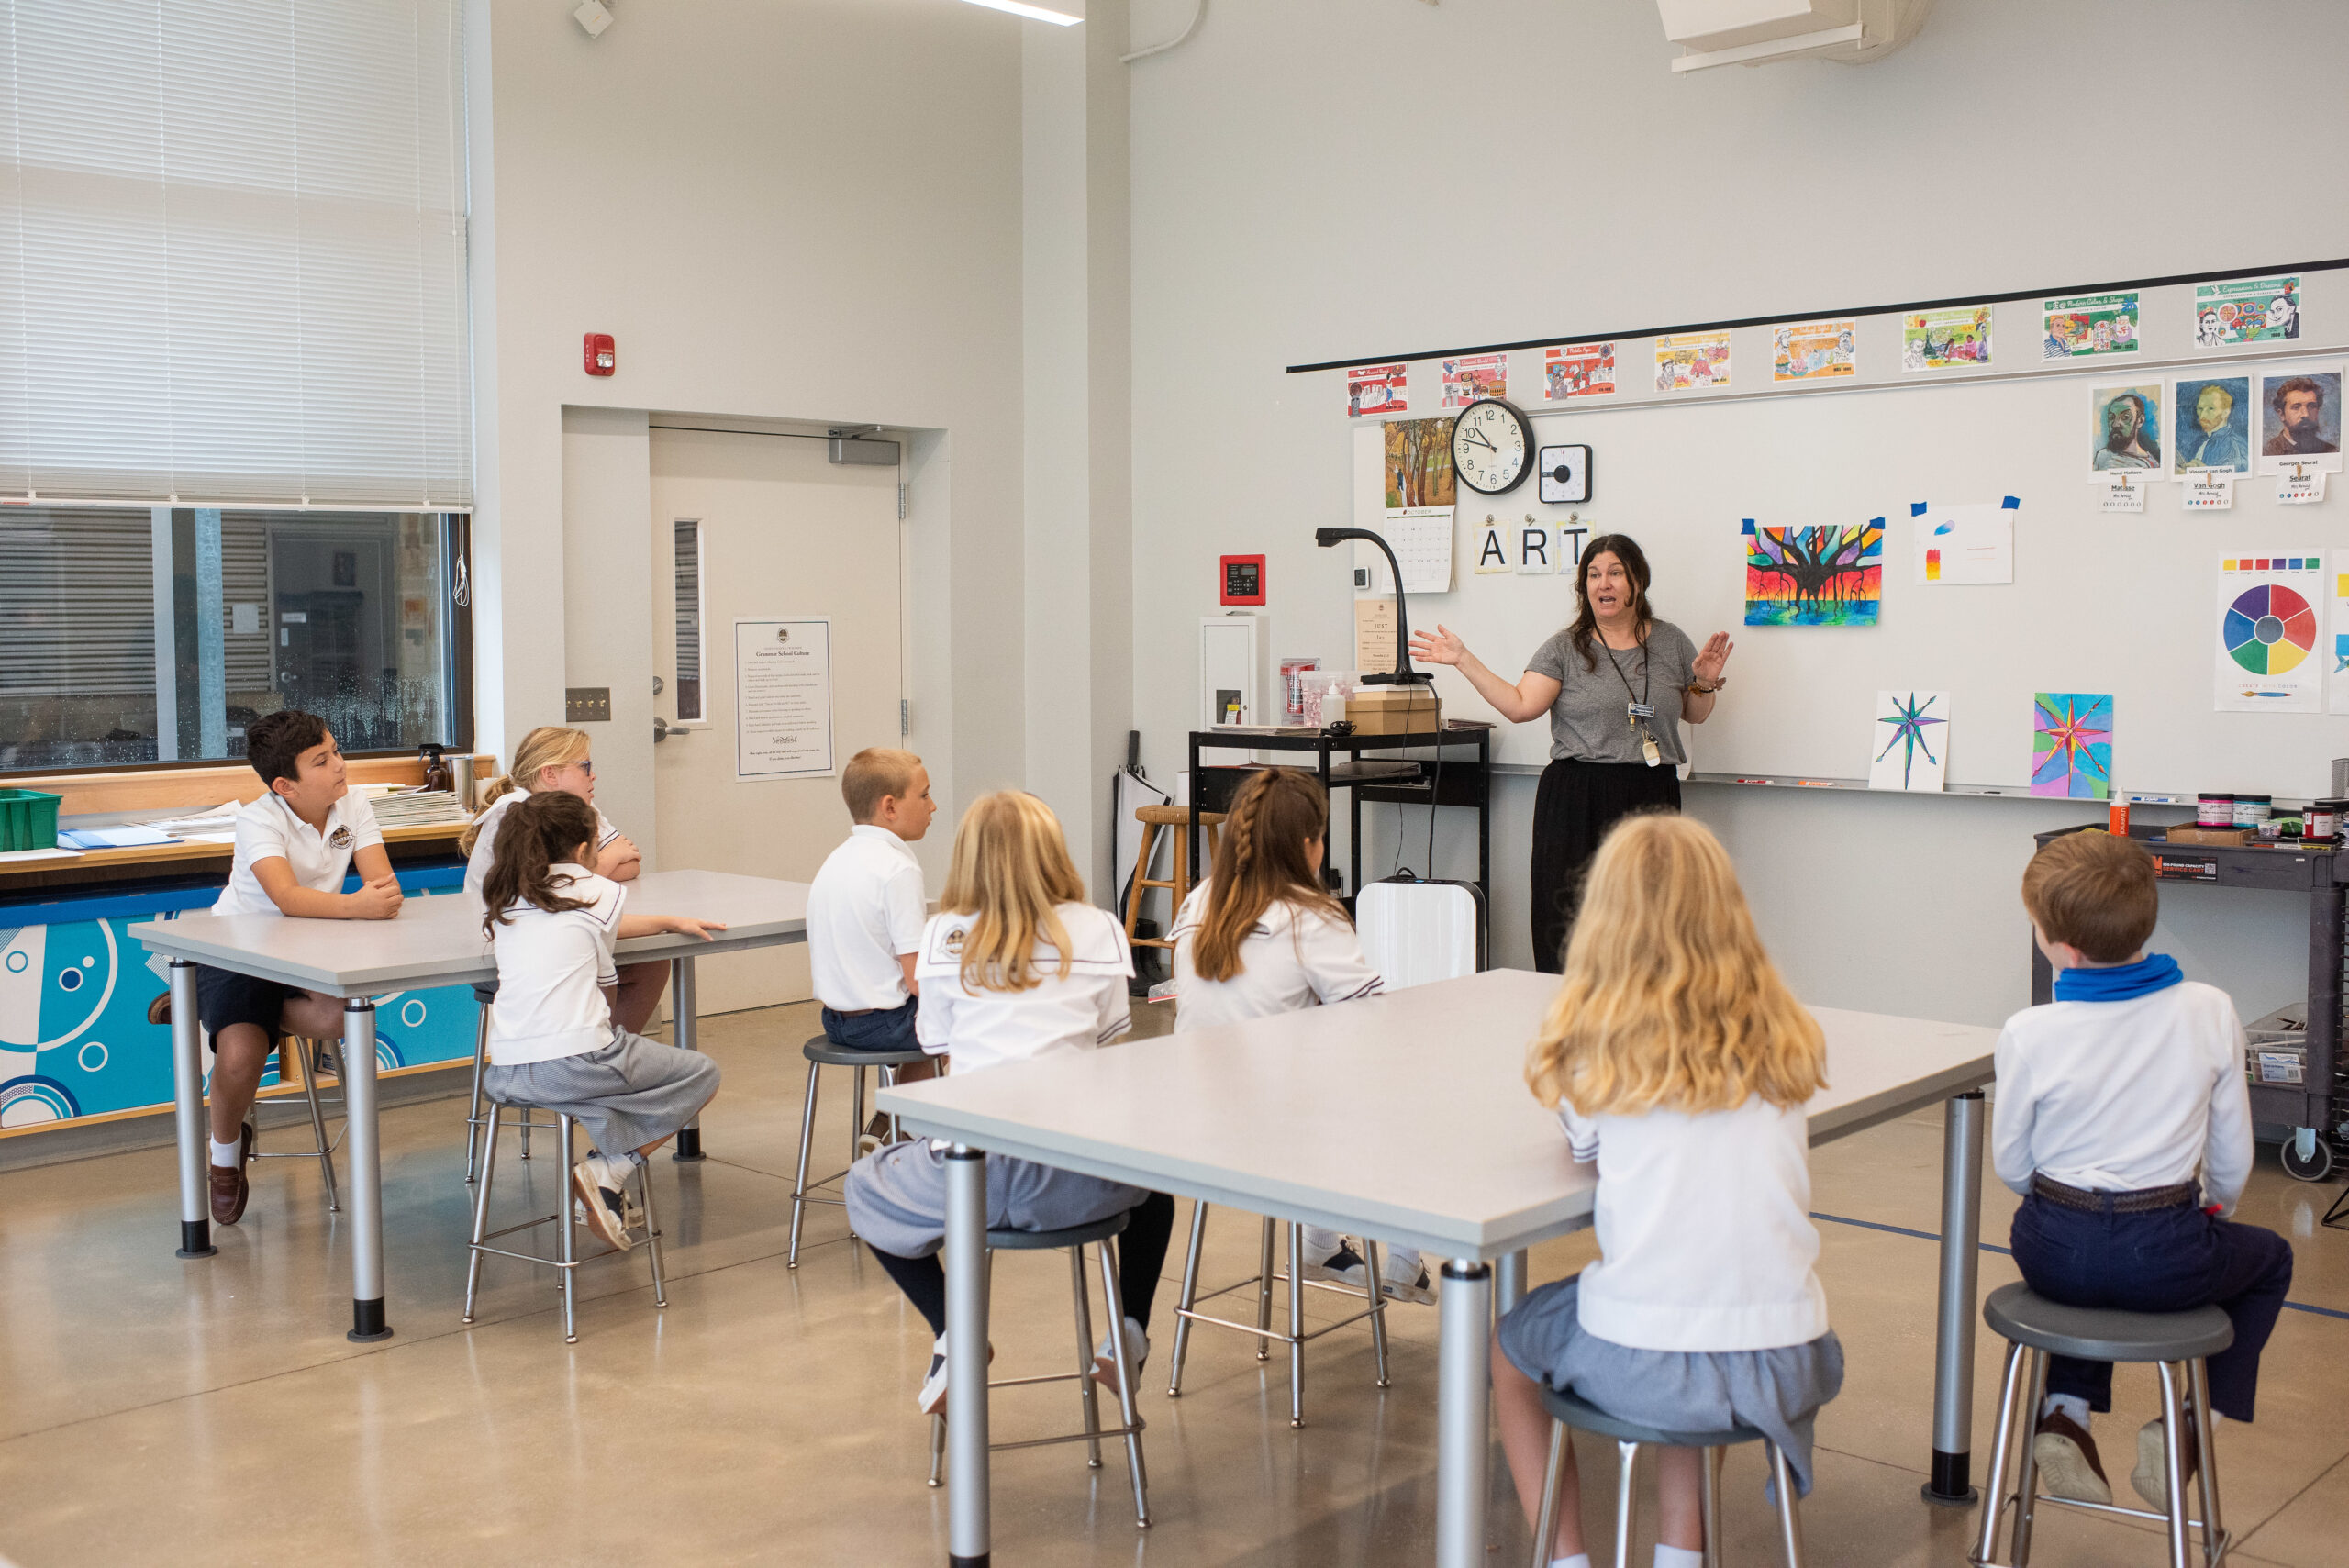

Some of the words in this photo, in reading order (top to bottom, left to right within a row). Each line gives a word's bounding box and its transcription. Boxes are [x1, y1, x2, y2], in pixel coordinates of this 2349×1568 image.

[1486, 410, 1494, 421] 12
[1501, 414, 1505, 424] 1
[1474, 417, 1482, 427] 11
[1464, 428, 1475, 438] 10
[1510, 424, 1517, 435] 2
[1463, 443, 1469, 453] 9
[1514, 441, 1521, 451] 3
[1467, 460, 1475, 470] 8
[1512, 458, 1519, 467] 4
[1478, 471, 1485, 481] 7
[1490, 474, 1497, 484] 6
[1503, 470, 1509, 480] 5
[1480, 528, 1588, 566] ART
